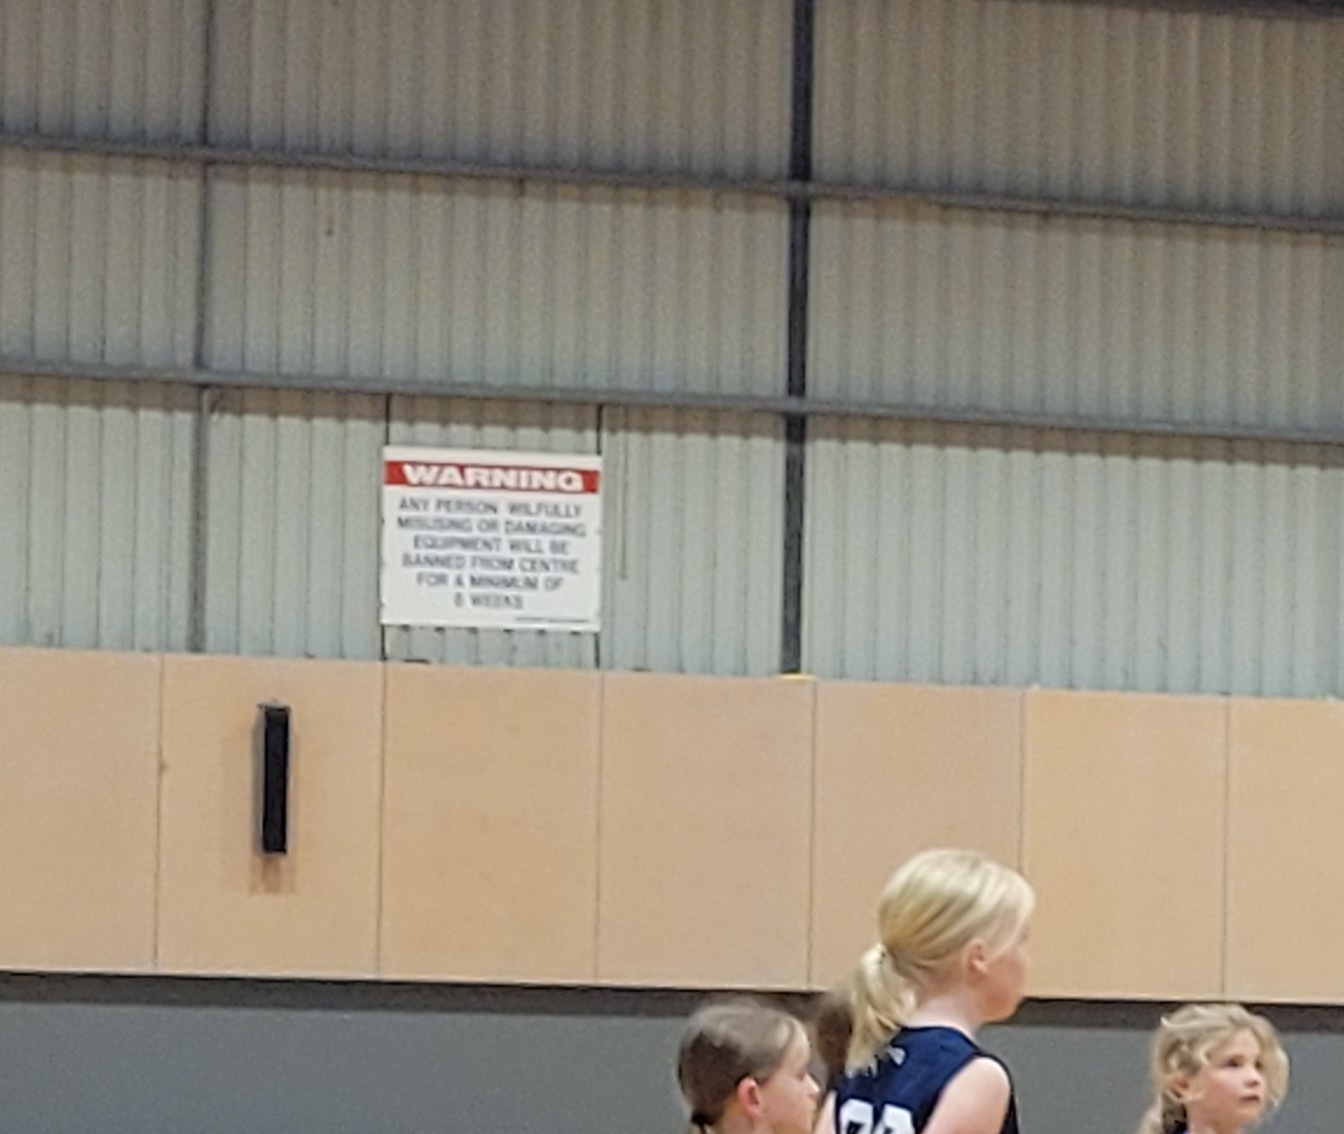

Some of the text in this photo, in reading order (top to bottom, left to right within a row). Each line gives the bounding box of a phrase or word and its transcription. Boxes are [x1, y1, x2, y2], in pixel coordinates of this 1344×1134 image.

[401, 464, 585, 492] WARNING
[400, 497, 429, 512] ANY
[435, 498, 498, 514] PERSON
[477, 518, 499, 533] OR
[413, 534, 571, 556] EQUIPMENT WILL BE
[402, 552, 467, 570] BANNED
[470, 555, 515, 571] FROM
[415, 571, 449, 588] FOR
[454, 573, 465, 588] A
[543, 576, 565, 593] OF
